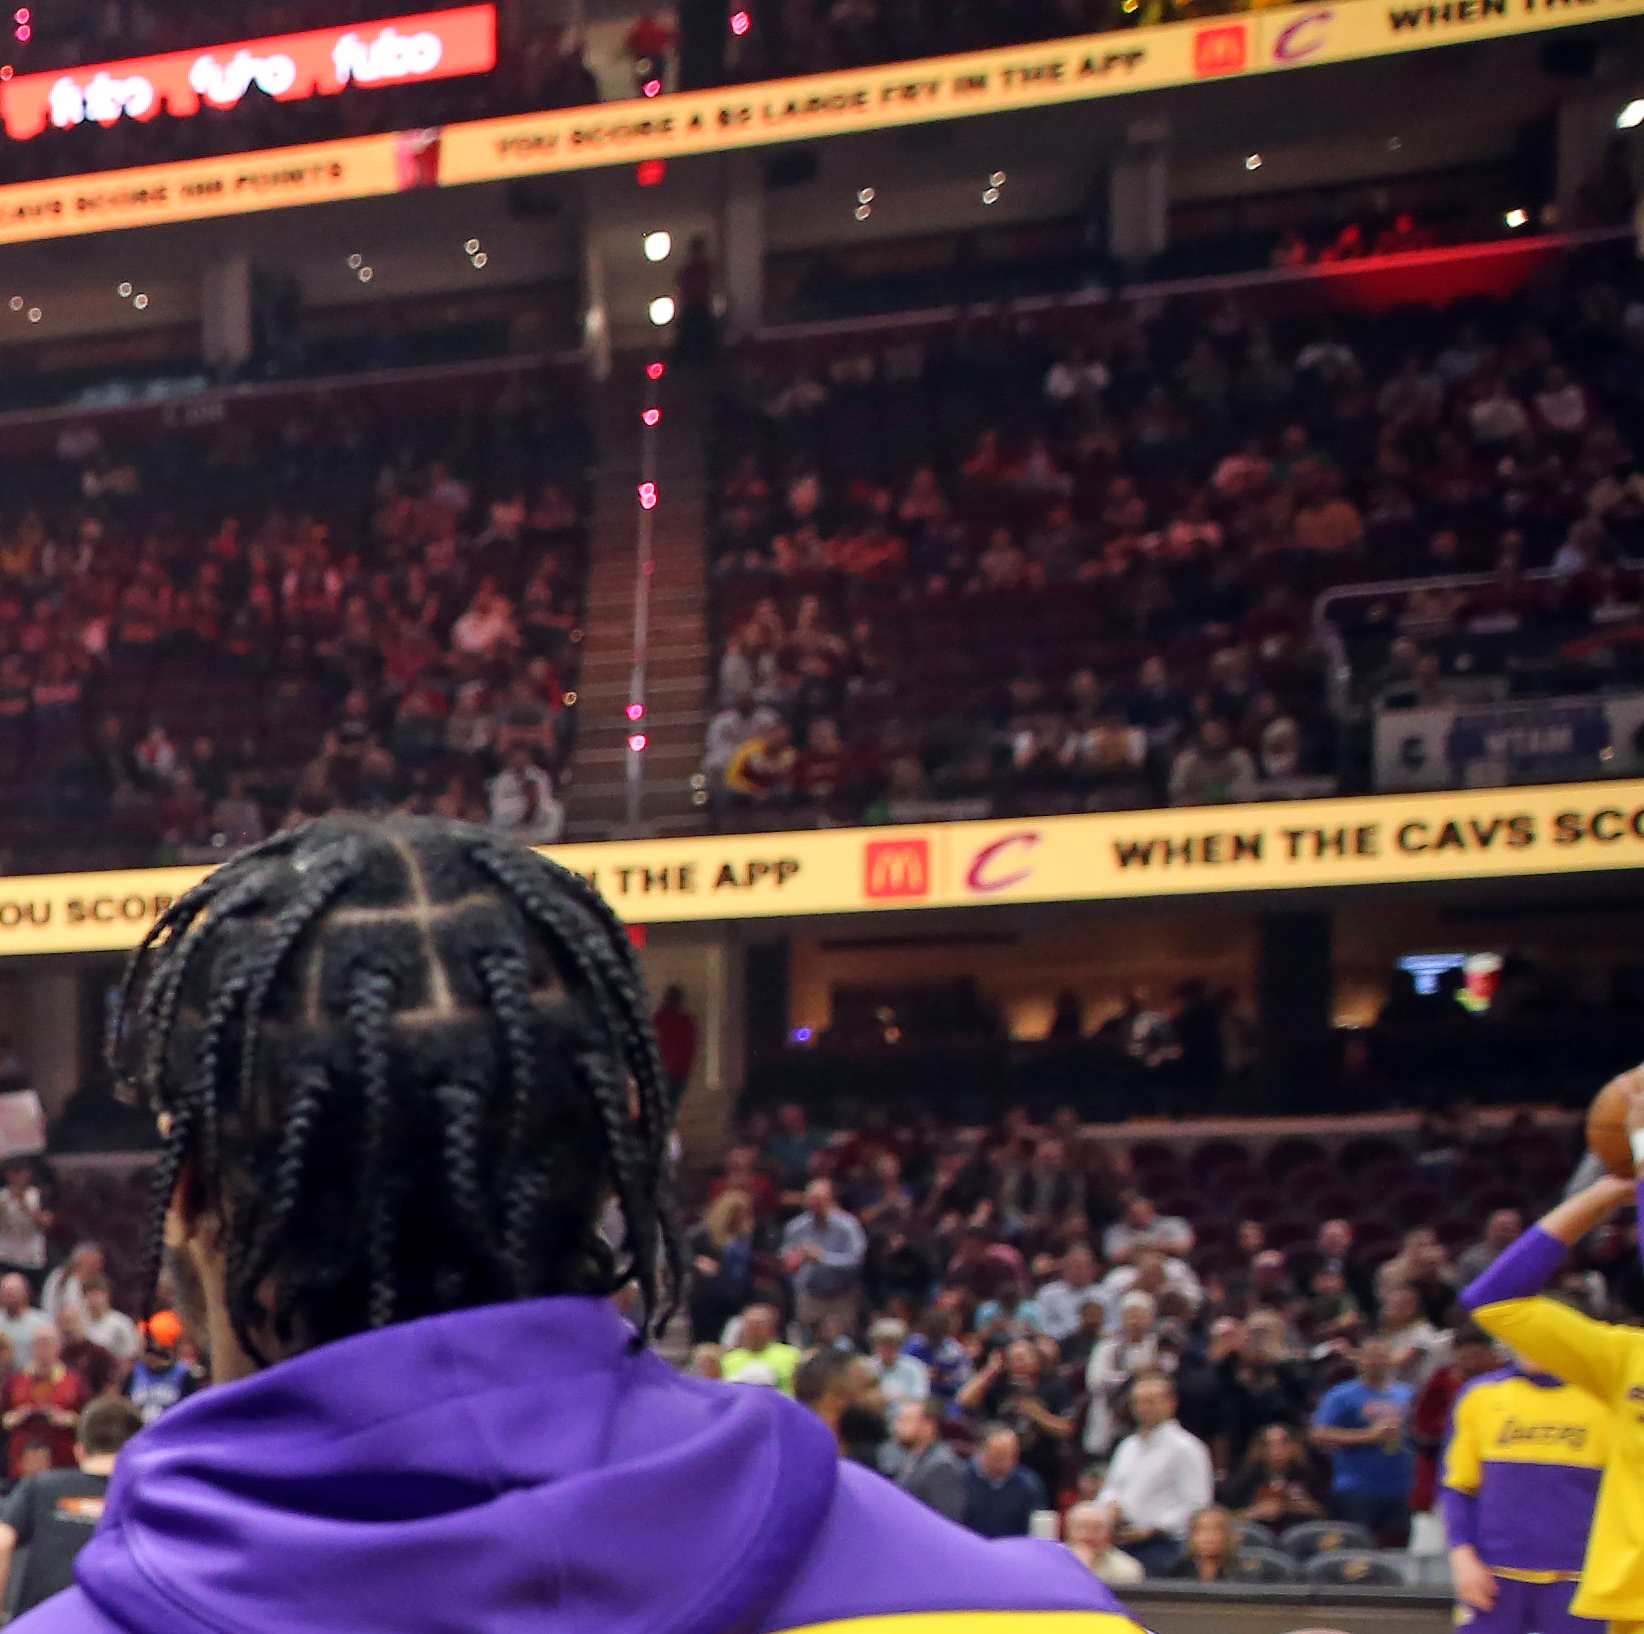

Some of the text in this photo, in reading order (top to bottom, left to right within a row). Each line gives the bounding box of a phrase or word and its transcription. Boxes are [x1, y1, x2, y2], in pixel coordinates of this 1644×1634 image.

[1112, 830, 1264, 868] WHEN
[1283, 824, 1380, 860] THE
[1396, 815, 1537, 856] CAVS
[615, 863, 696, 895] THE
[712, 859, 801, 891] APP
